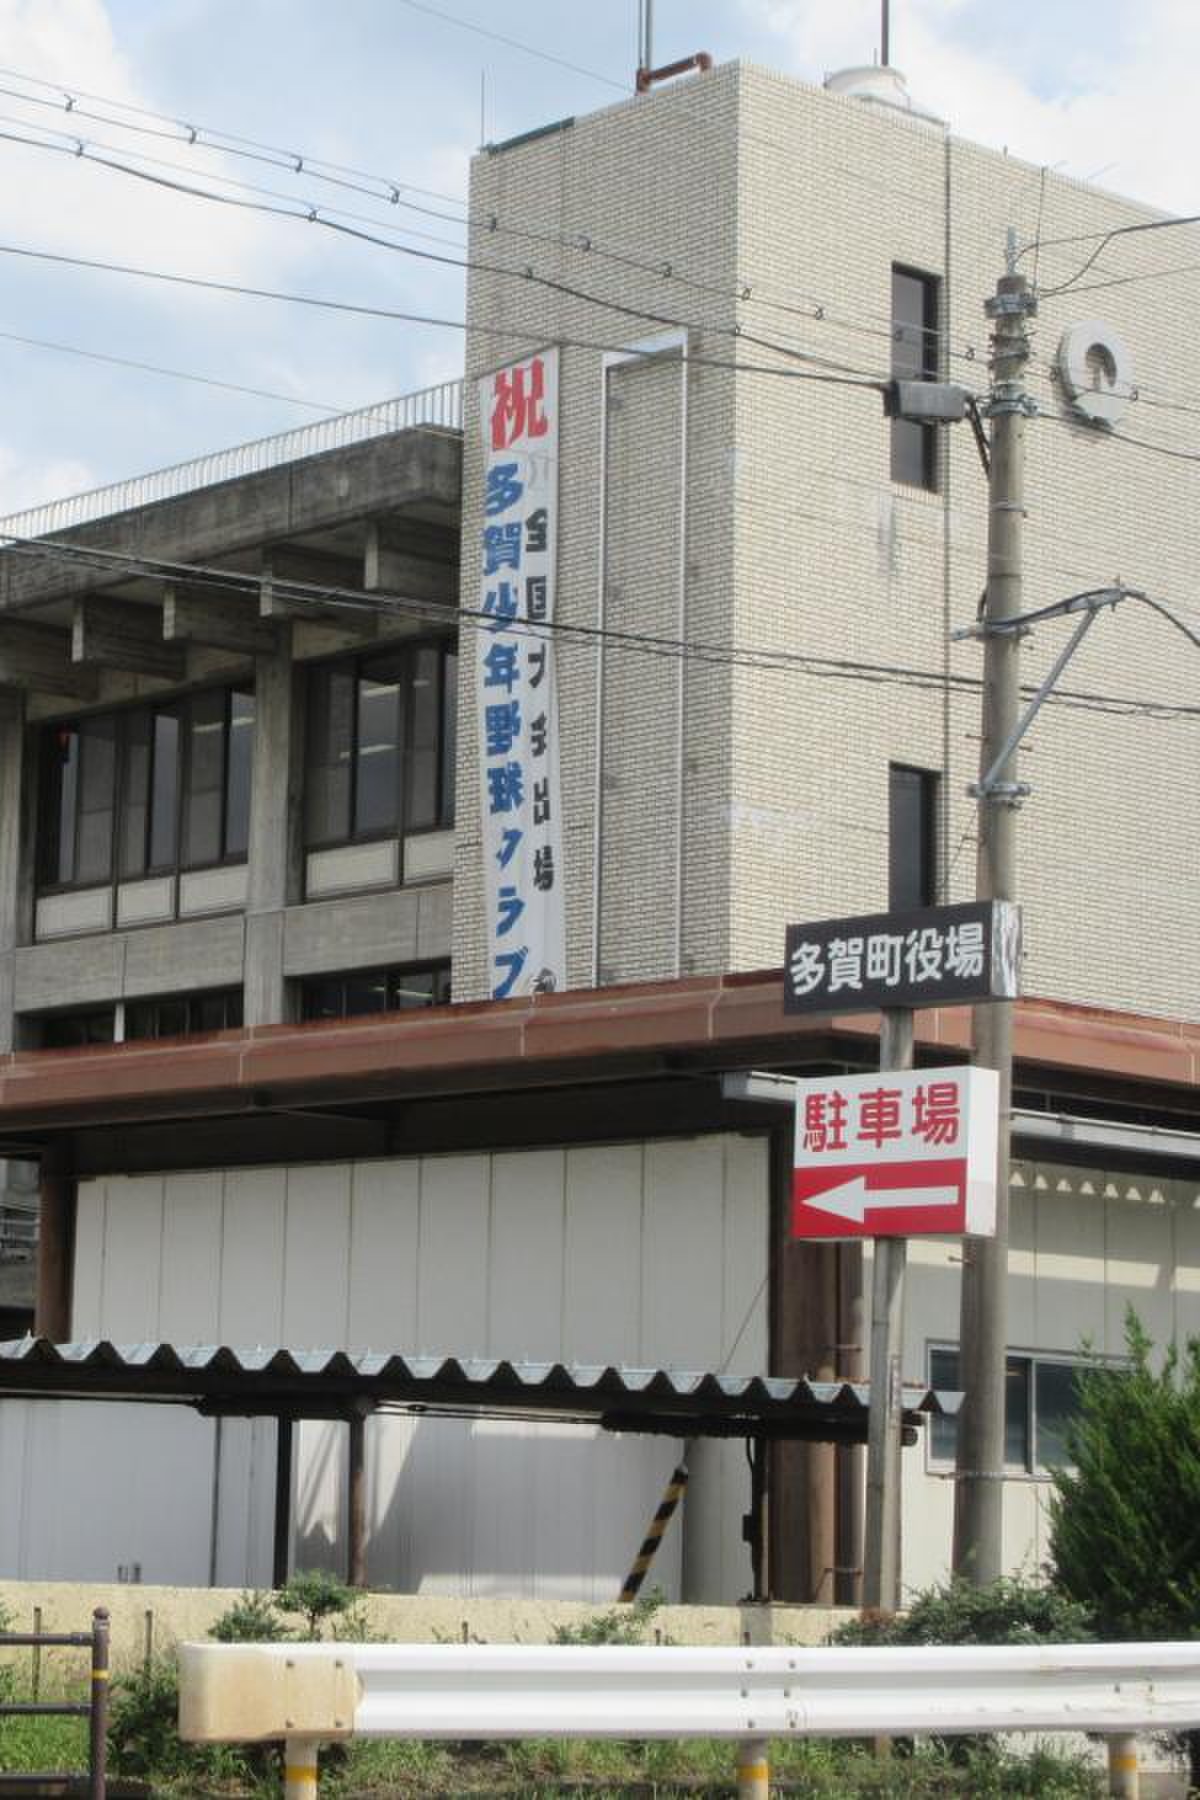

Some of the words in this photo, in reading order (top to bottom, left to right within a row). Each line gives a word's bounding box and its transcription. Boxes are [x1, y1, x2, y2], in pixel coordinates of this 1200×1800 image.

[490, 356, 548, 450] 祝
[482, 463, 528, 998] 多賀少年野球クラブ
[790, 922, 985, 996] 多賀町役場
[803, 1081, 961, 1153] 駐車場
